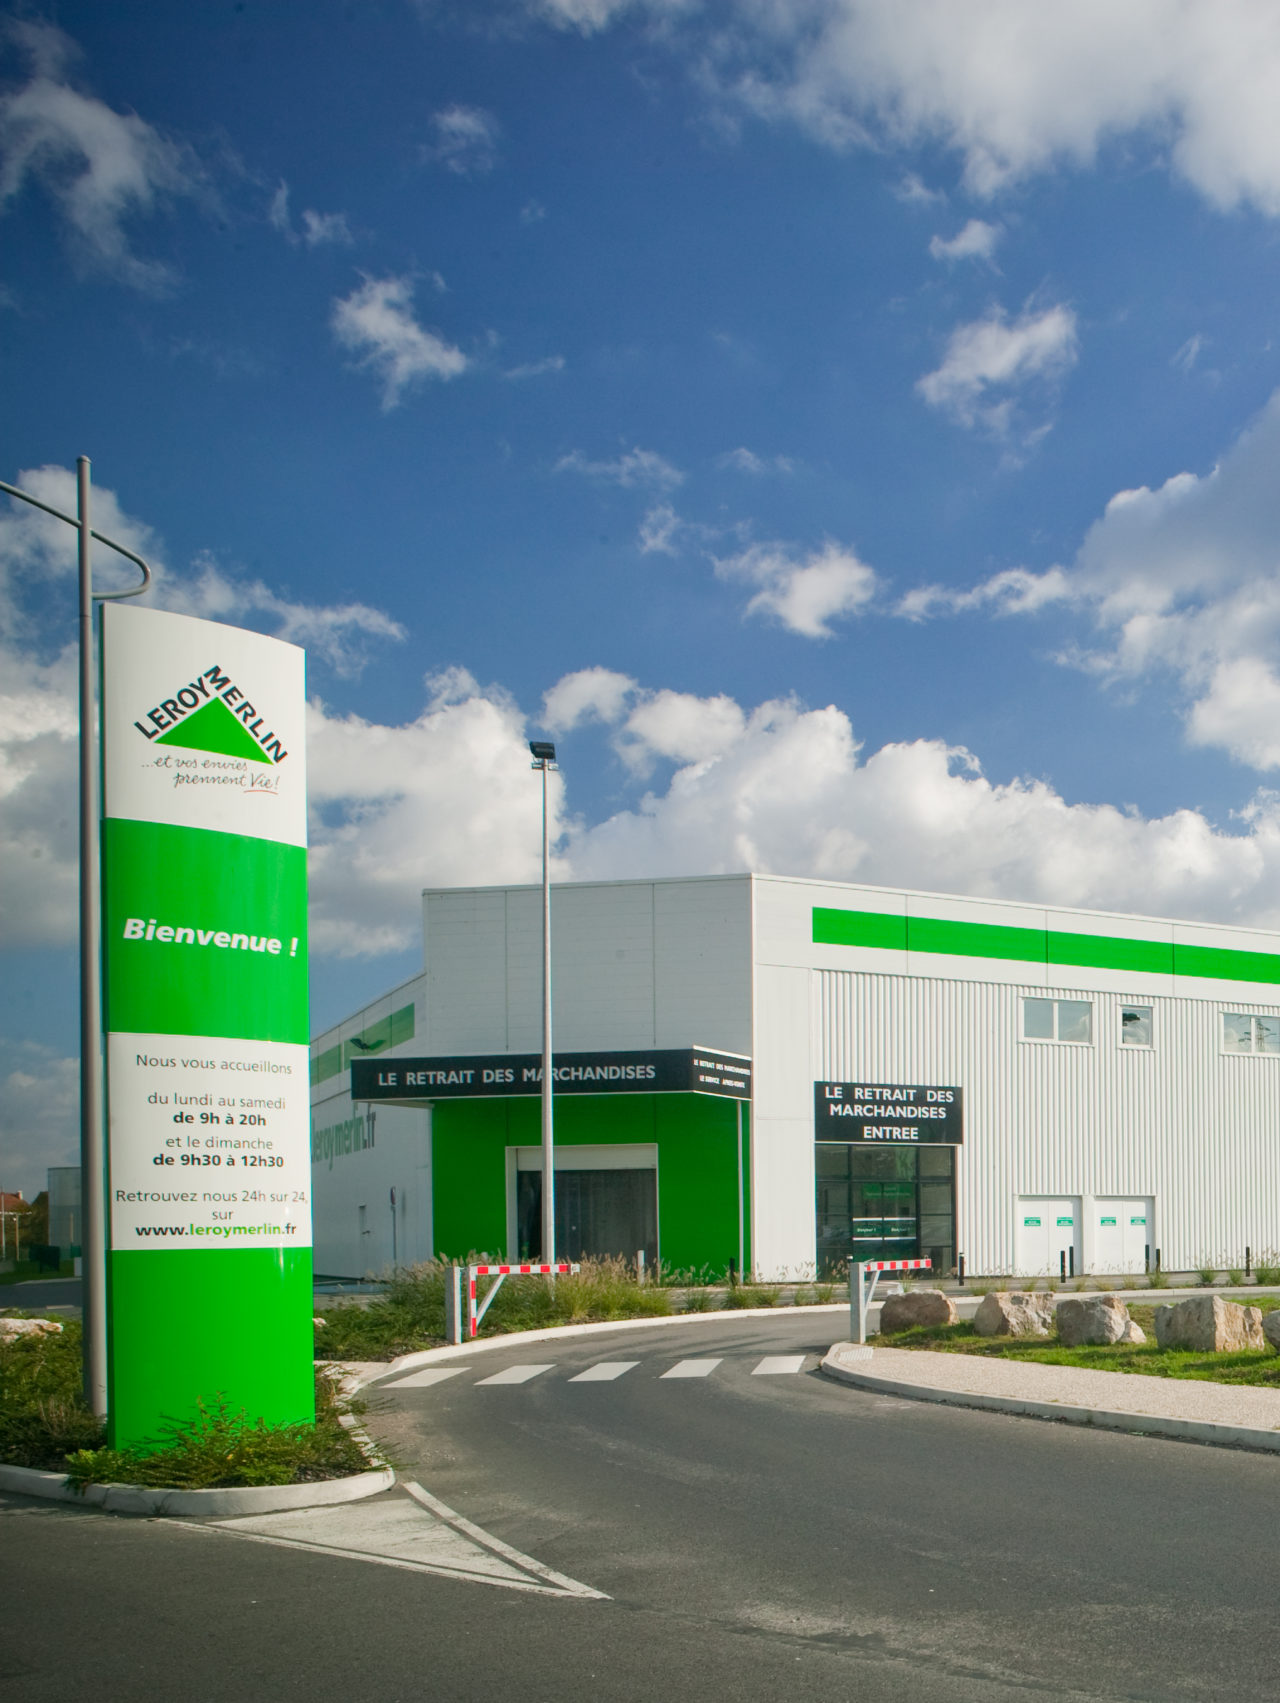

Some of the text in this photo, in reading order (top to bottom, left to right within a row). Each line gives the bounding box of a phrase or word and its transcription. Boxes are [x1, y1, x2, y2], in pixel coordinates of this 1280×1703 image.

[134, 665, 288, 764] LEROY MERLIN
[174, 758, 198, 769] vos
[201, 759, 248, 771] envies
[172, 772, 247, 788] prennent
[123, 918, 282, 955] Bienvenue
[136, 1054, 292, 1074] Nous vous accueillons
[378, 1072, 397, 1086] LE
[406, 1070, 475, 1086] RETRAIT
[482, 1069, 514, 1083] DES
[147, 1092, 286, 1109] du lundi au samedi
[825, 1086, 954, 1103] LE RETRAIT DES
[173, 1111, 266, 1126] de 9h à 20h
[829, 1103, 947, 1119] MARCHANDISES
[863, 1126, 919, 1140] ENTREE
[165, 1135, 273, 1150] et le dimanche
[153, 1153, 284, 1167] de 9h30 à 12h30
[116, 1190, 197, 1202] Retrouvez
[203, 1191, 237, 1202] nous
[242, 1190, 266, 1202] 24h
[270, 1193, 288, 1202] sur
[211, 1210, 234, 1220] sur
[135, 1223, 296, 1238] www.leroymerlin.fr
